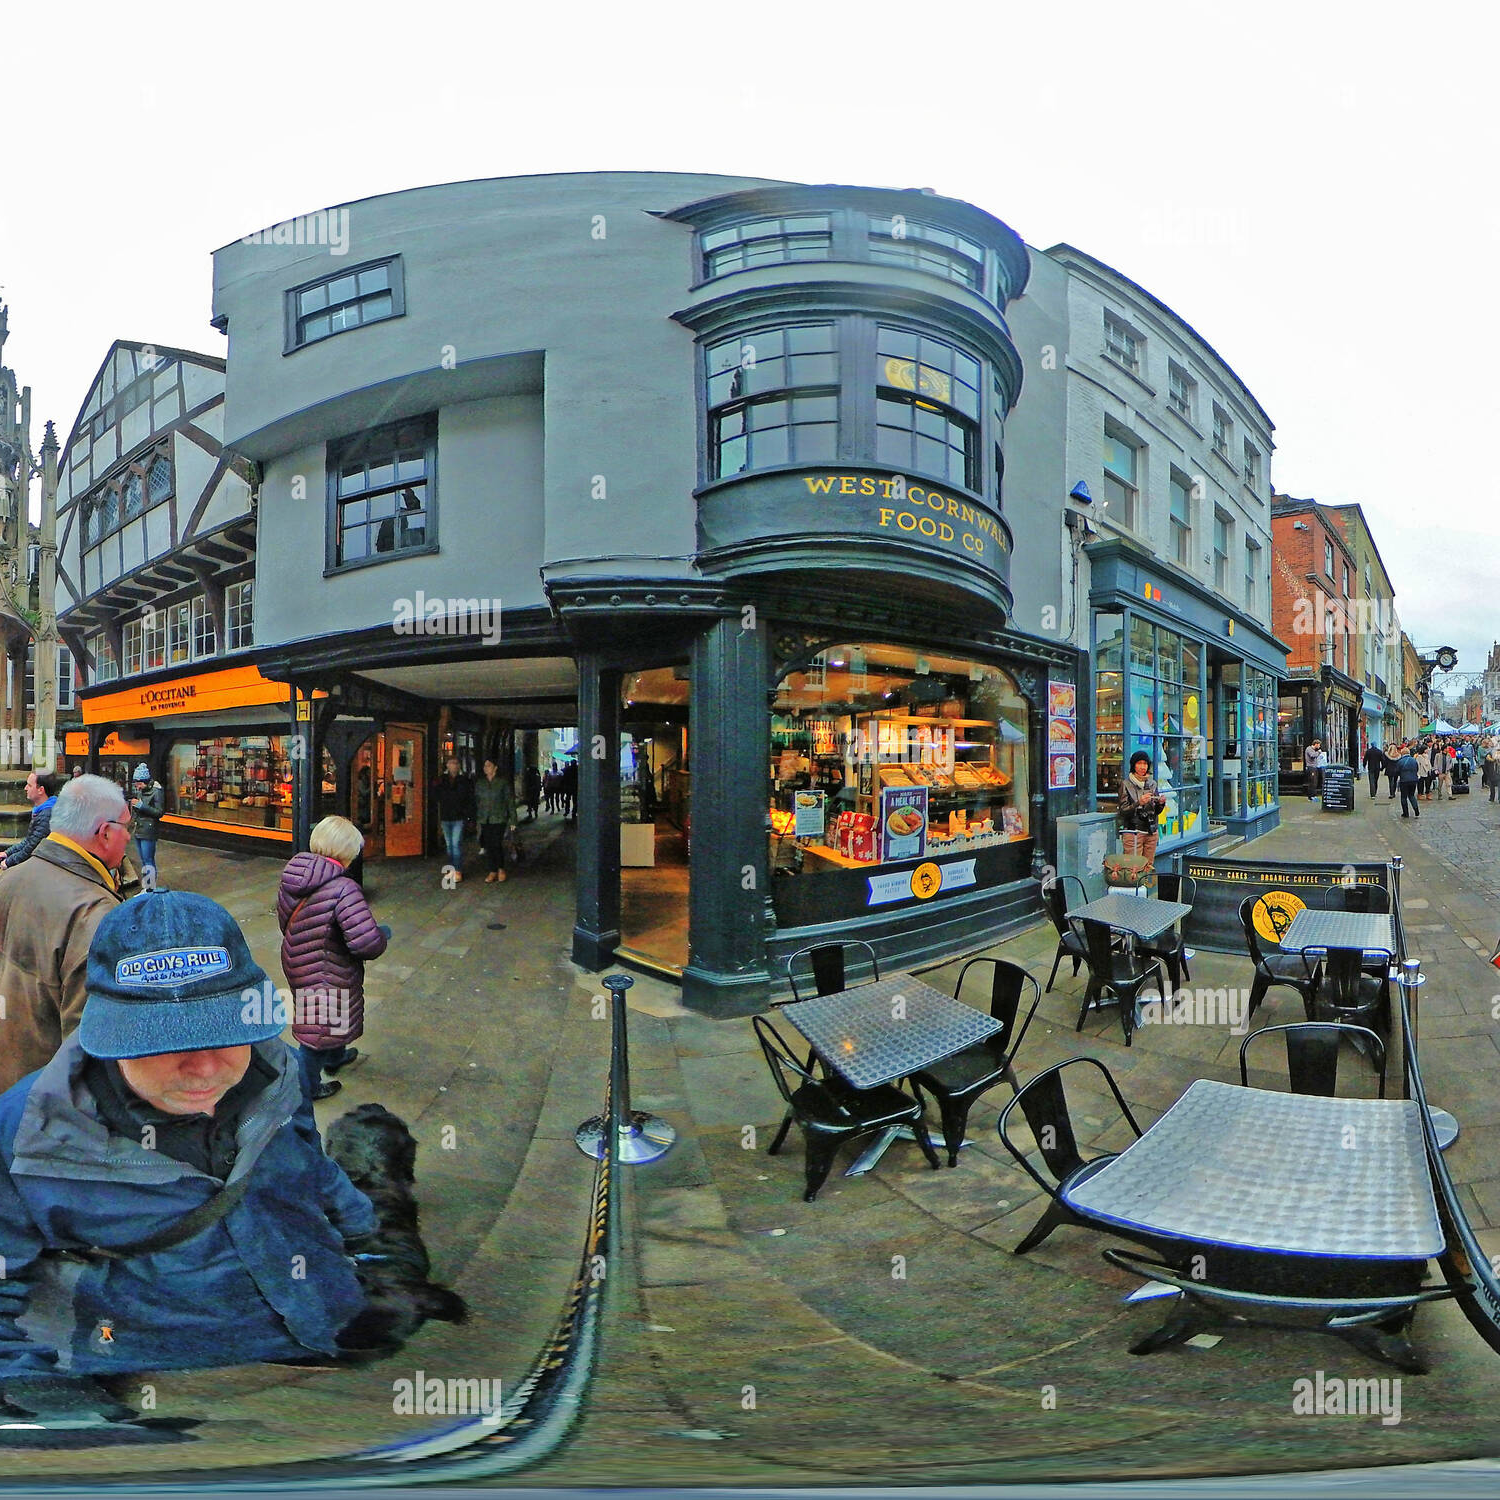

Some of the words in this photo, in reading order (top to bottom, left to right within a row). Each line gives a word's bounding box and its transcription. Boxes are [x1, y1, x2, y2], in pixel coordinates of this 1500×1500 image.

[803, 476, 896, 498] WEST
[907, 486, 1008, 552] CORNWALL
[879, 507, 954, 542] FOOD
[140, 685, 196, 706] L'OCCITANE
[158, 701, 186, 711] PROVENCE
[299, 703, 309, 718] H
[1189, 868, 1215, 877] PASTIES
[1227, 872, 1248, 880] CAKES
[1260, 874, 1290, 883] ORGANIC
[1293, 875, 1318, 884] COFFEE
[121, 961, 142, 976] OLD
[143, 956, 184, 973] GUYS
[187, 952, 220, 967] RULE
